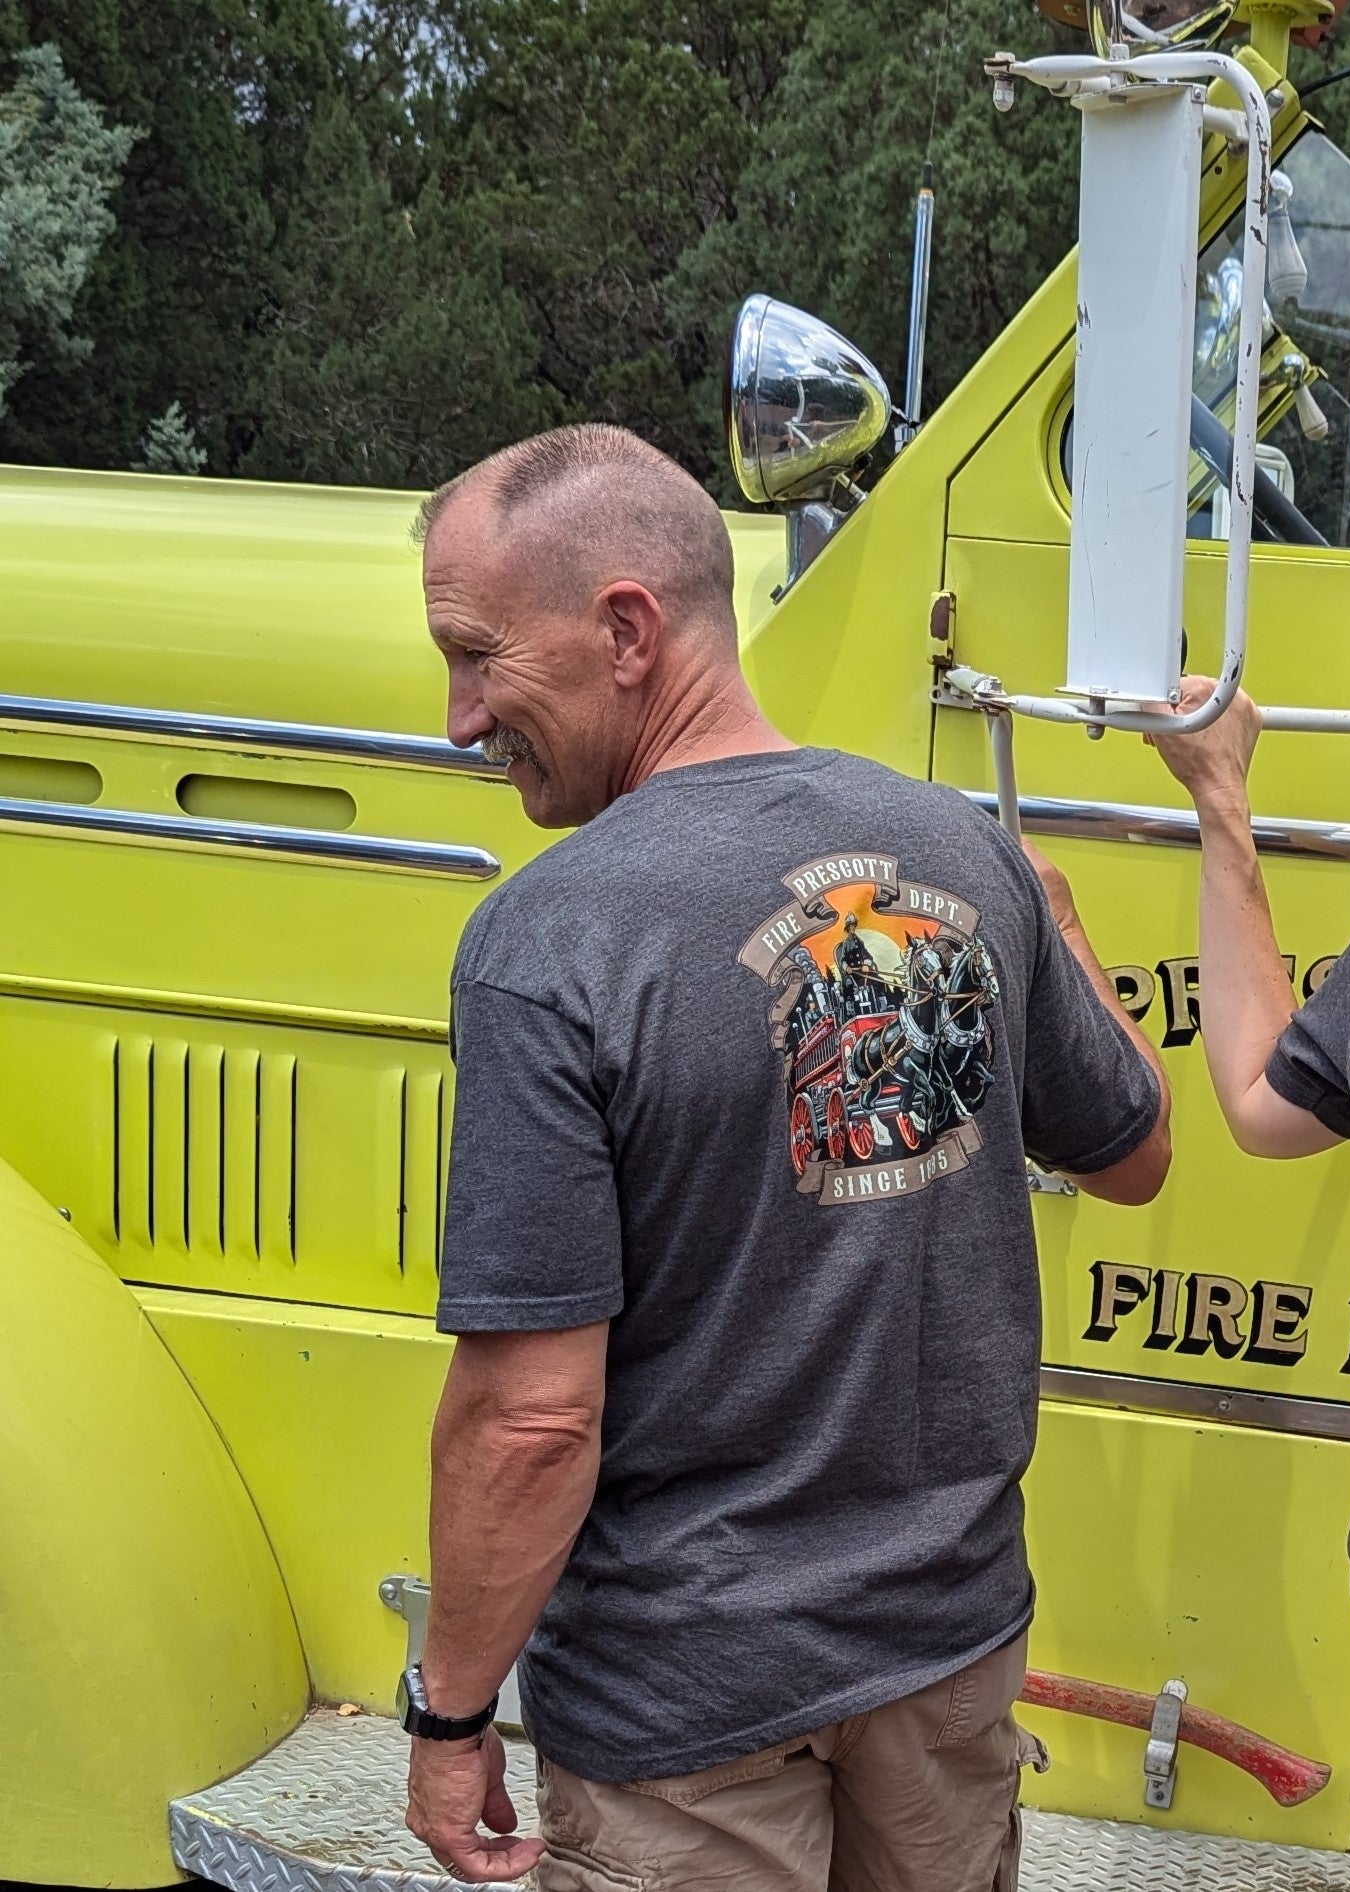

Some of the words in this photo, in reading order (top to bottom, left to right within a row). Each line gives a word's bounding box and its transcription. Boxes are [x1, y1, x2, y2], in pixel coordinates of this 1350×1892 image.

[793, 858, 893, 898] PRESCOTT
[762, 912, 801, 954] FIRE
[909, 889, 963, 925] DEPT.
[833, 1168, 907, 1198] SINCE
[1081, 1260, 1312, 1367] FIRE
